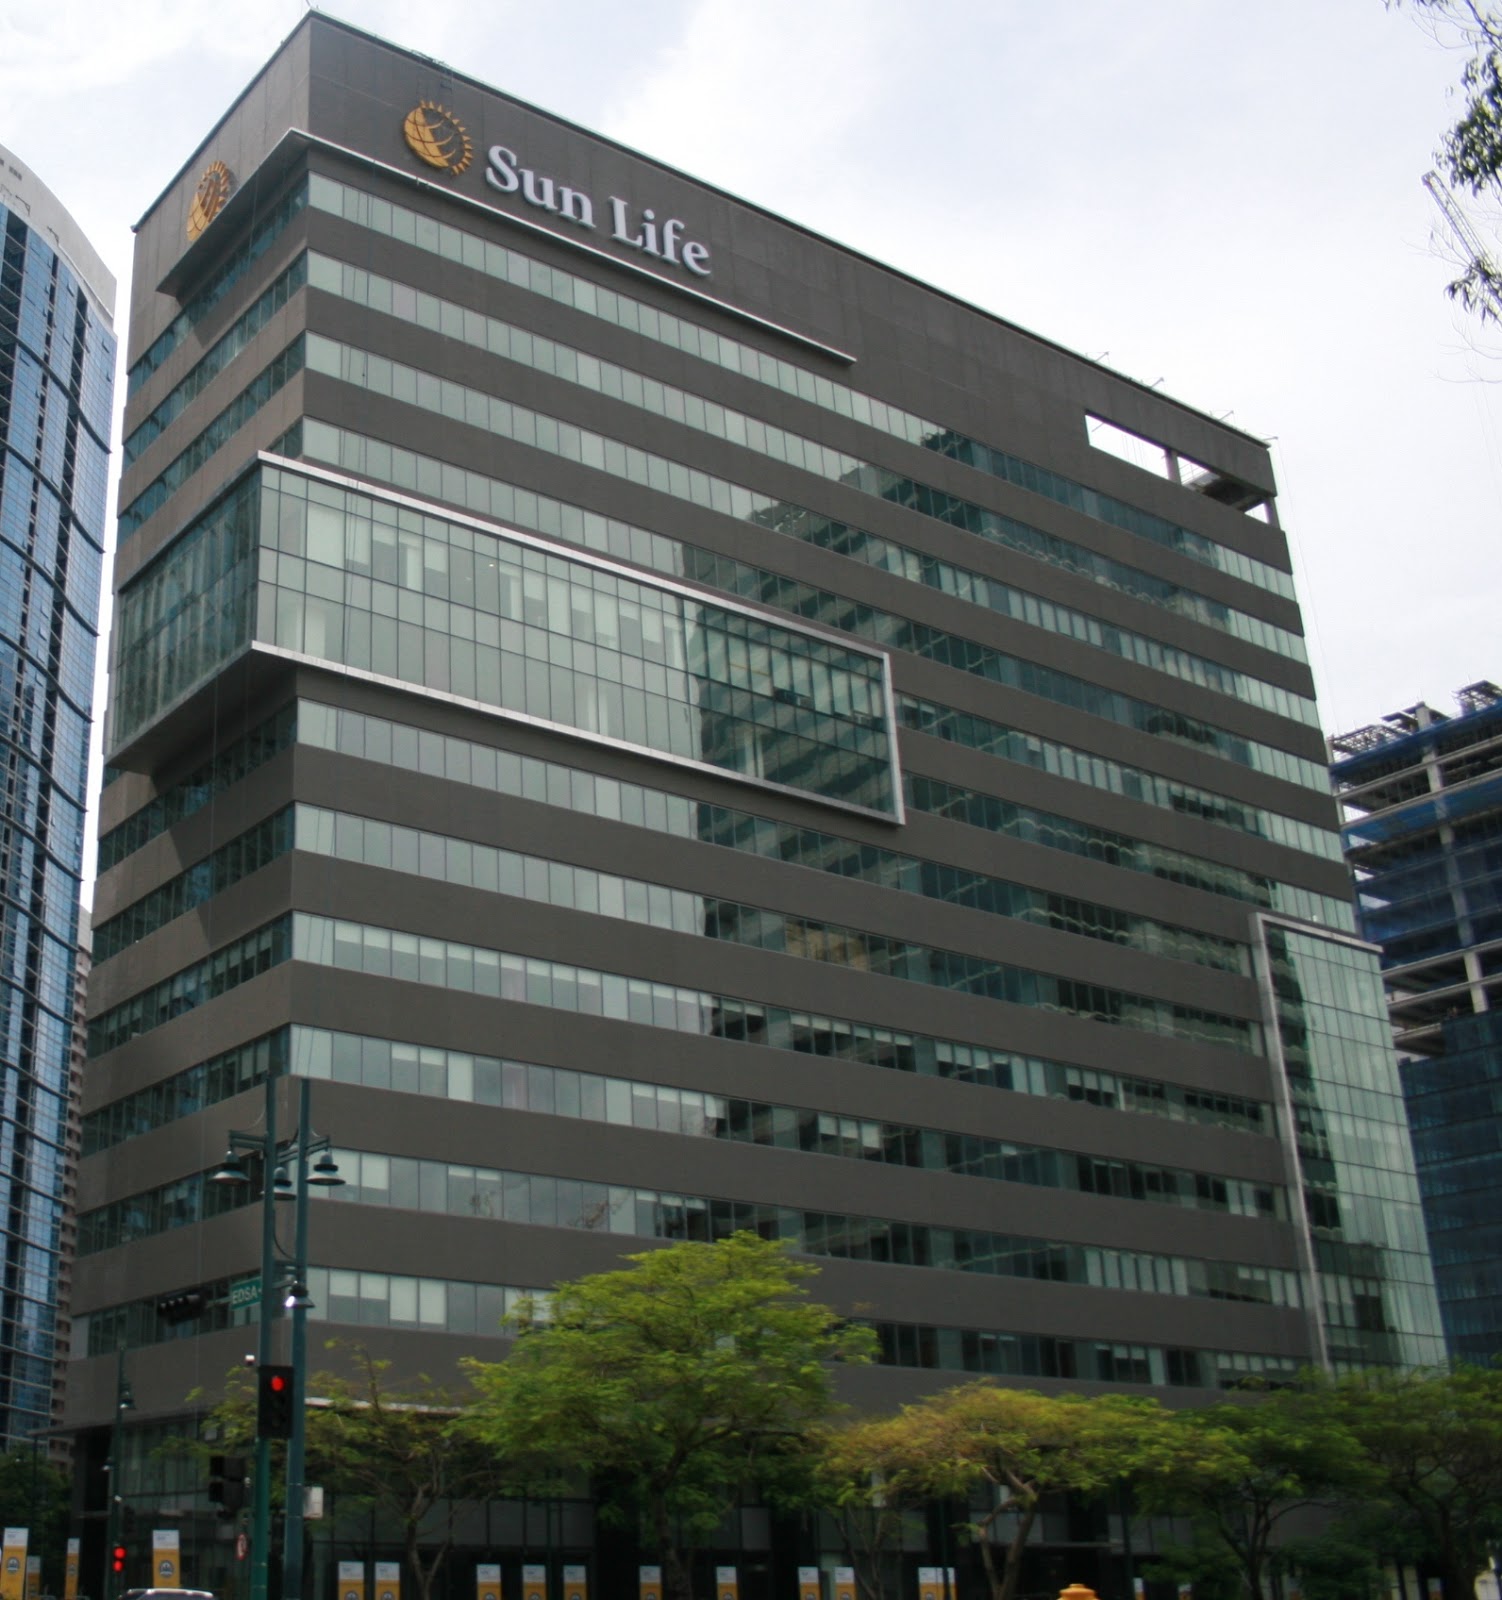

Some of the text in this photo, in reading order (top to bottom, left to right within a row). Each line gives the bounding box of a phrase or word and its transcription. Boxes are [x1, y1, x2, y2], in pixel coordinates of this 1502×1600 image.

[485, 145, 711, 276] Sun Life
[232, 1285, 258, 1304] EDSA
